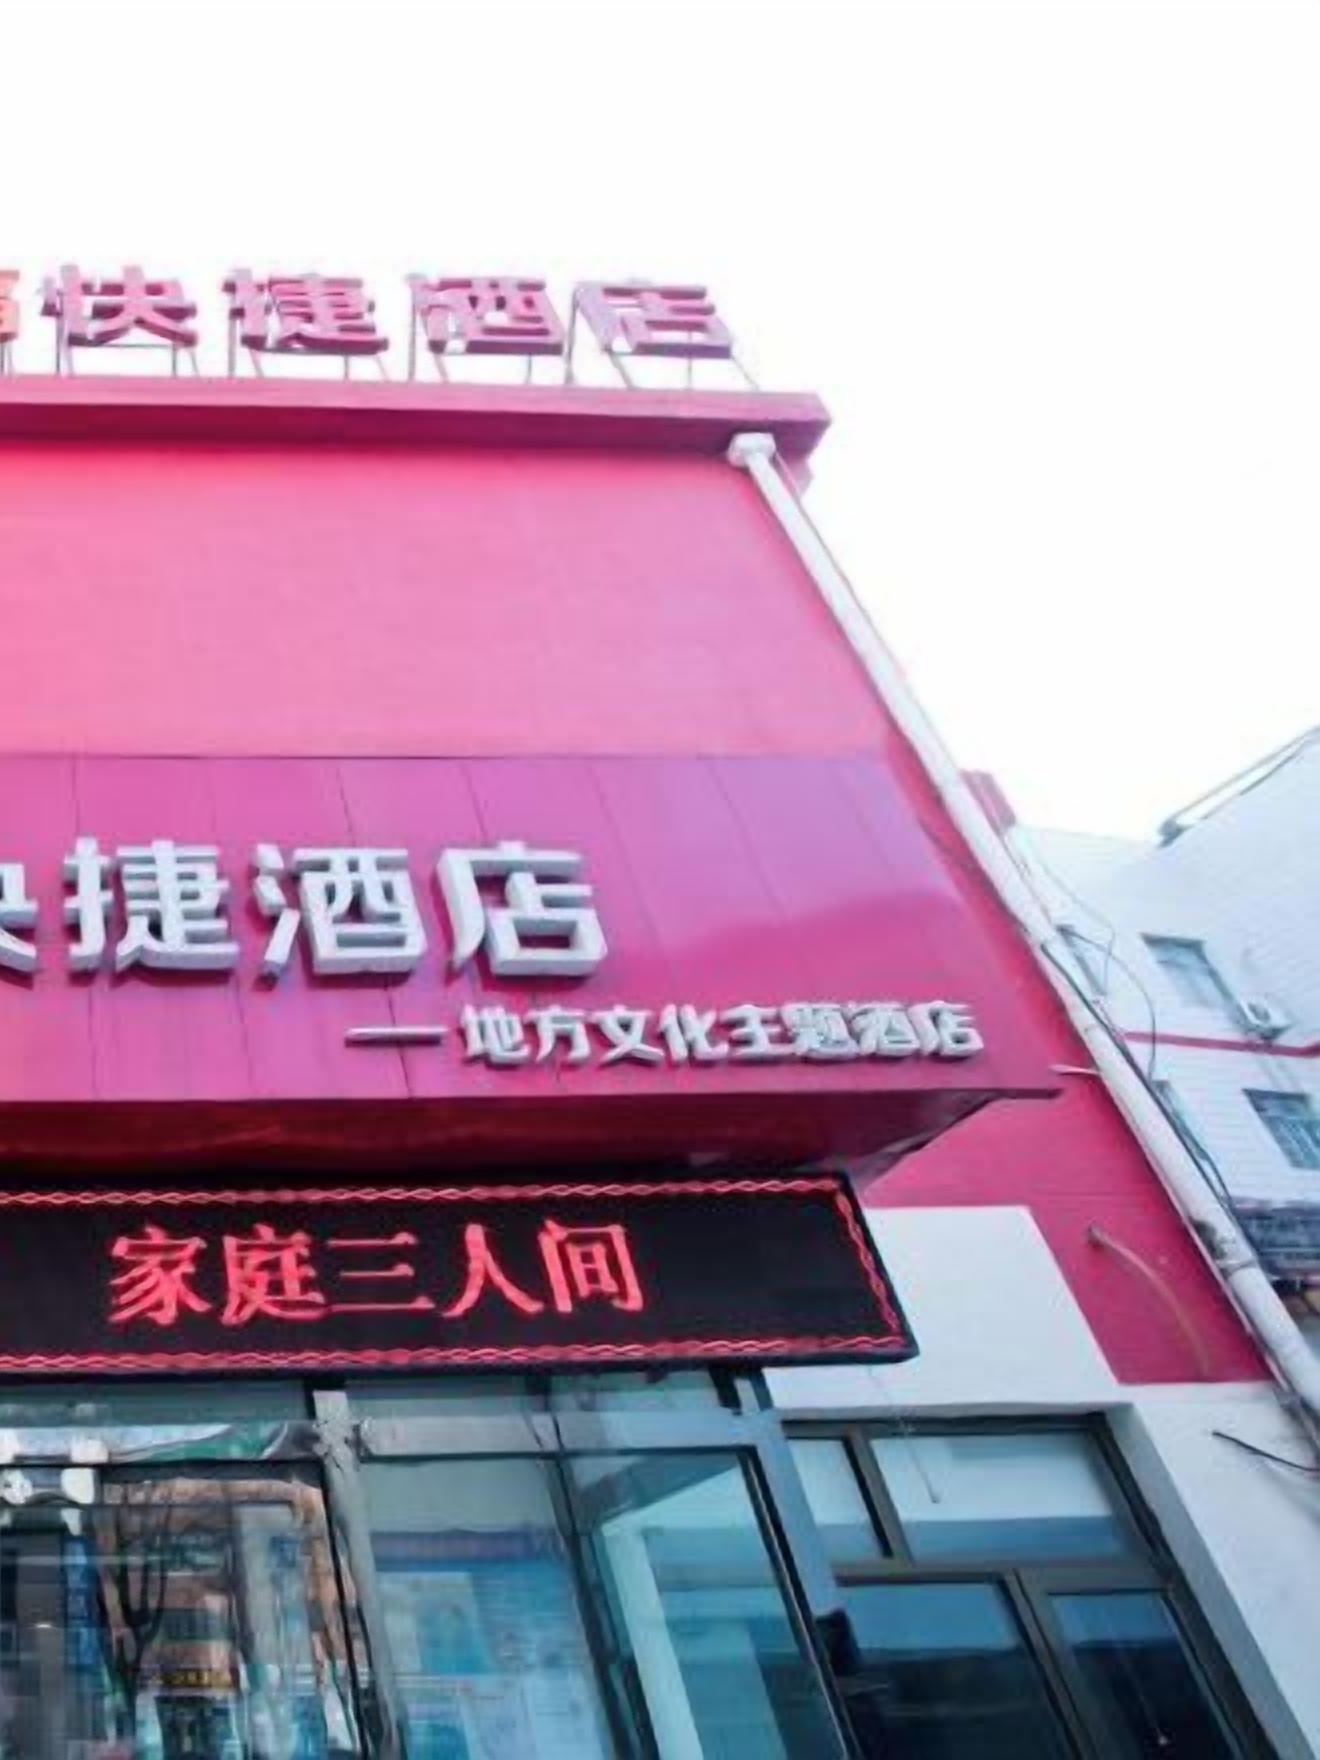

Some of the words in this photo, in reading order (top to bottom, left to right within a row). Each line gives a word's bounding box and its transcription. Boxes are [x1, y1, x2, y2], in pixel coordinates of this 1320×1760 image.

[108, 1218, 647, 1327] 家庭三人间
